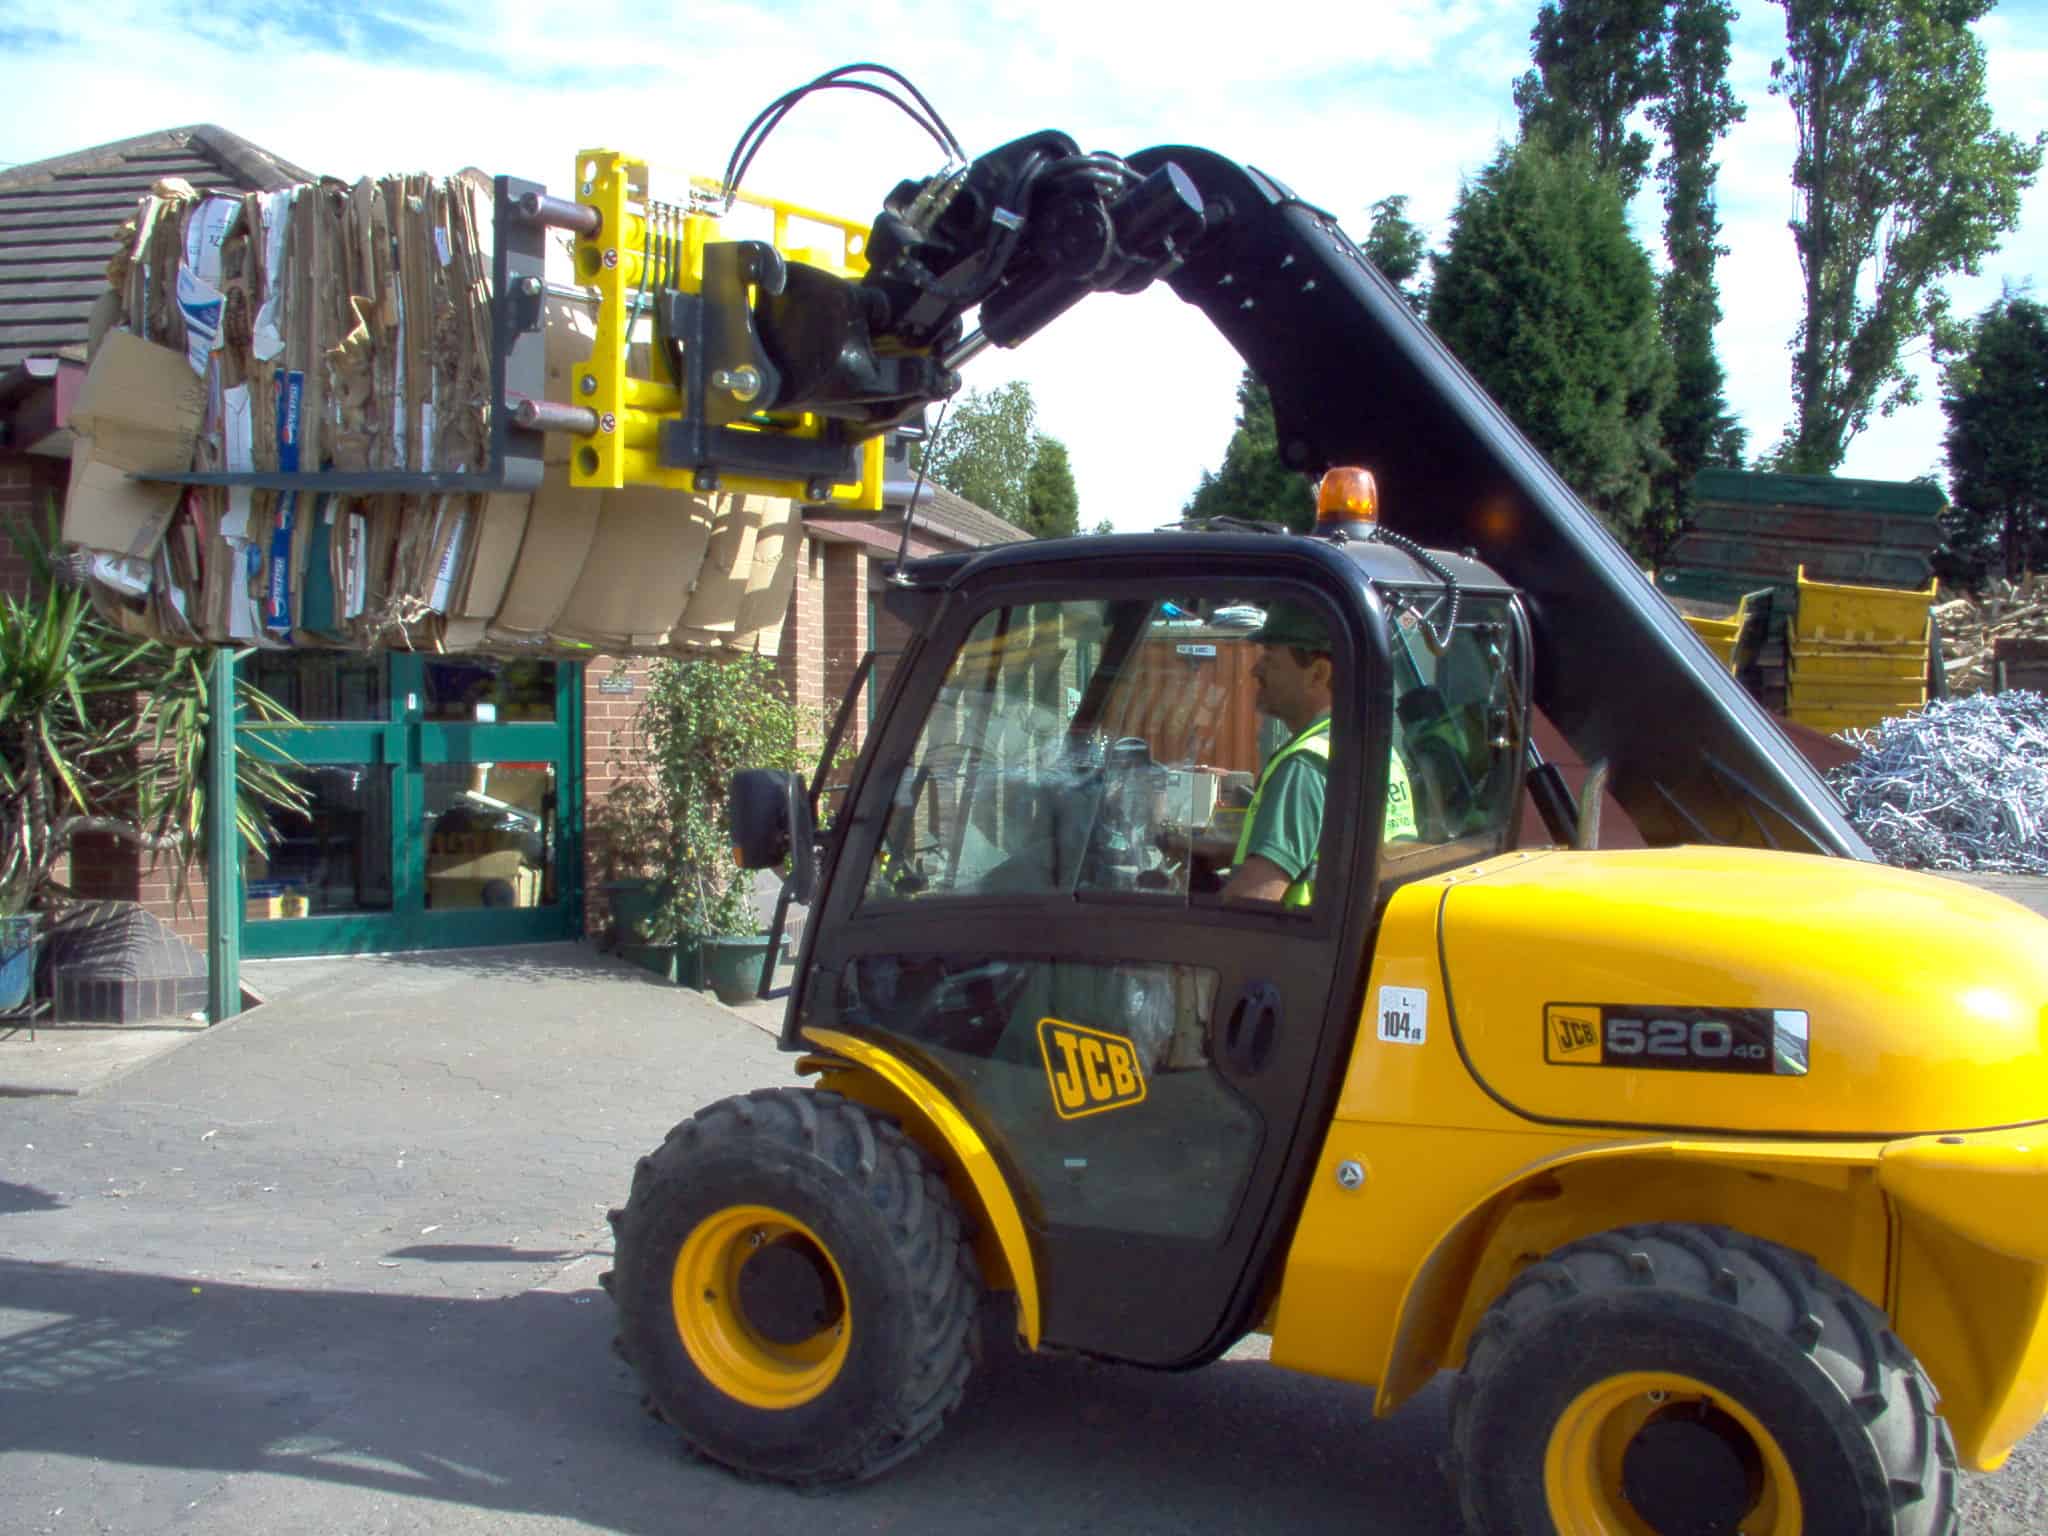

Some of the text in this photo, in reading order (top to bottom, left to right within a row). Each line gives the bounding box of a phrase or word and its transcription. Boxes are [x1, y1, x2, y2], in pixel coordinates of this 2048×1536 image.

[1384, 1010, 1410, 1039] 104
[1559, 1018, 1766, 1060] JCB 520 40
[1054, 1030, 1137, 1108] JCB
